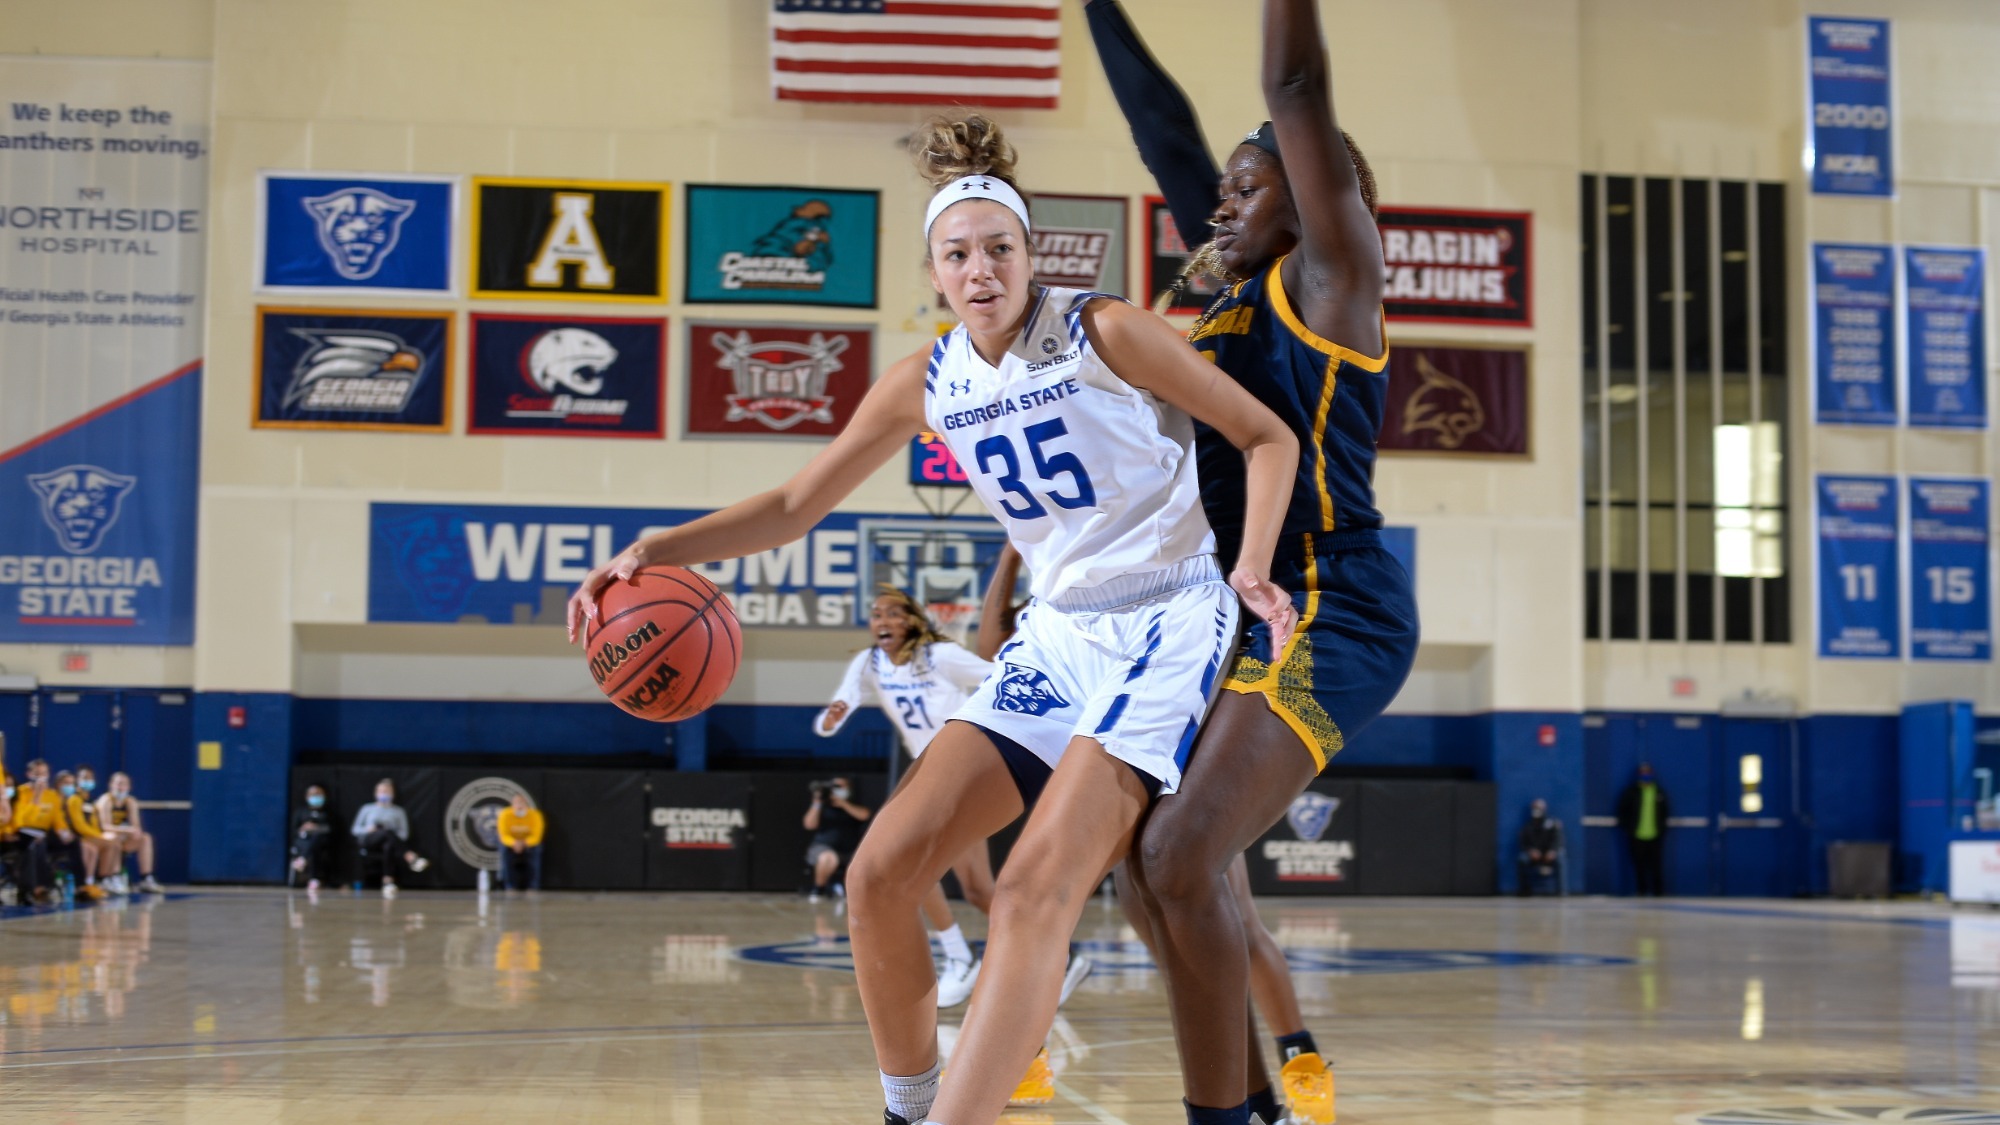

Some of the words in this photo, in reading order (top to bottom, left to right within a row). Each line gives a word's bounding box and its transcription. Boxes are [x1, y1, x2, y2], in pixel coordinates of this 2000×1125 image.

[12, 103, 51, 122] We
[60, 104, 121, 127] keep
[129, 106, 172, 125] the
[1815, 103, 1889, 130] 2000
[0, 132, 94, 151] anthers
[103, 135, 207, 160] moving.
[20, 237, 158, 256] HOSPITAL
[527, 193, 615, 288] A
[39, 290, 88, 303] Health
[94, 291, 128, 304] Care
[132, 292, 196, 305] Provider
[9, 310, 70, 327] Georgia
[75, 311, 114, 325] State
[118, 312, 185, 327] Athletics
[749, 365, 811, 399] TROY
[943, 398, 1019, 430] GEORGIA
[1019, 378, 1080, 411] STATE
[975, 416, 1097, 520] 35
[465, 522, 856, 588] WELME
[875, 530, 975, 590] TO
[0, 556, 162, 587] GEORGIA
[1840, 563, 1877, 602] 11
[1926, 565, 1975, 605] 15
[19, 587, 137, 617] STATE
[590, 620, 663, 685] Wilson
[620, 663, 681, 711] NCAA
[896, 695, 935, 730] 21
[651, 807, 747, 828] GEORGIA
[665, 826, 734, 844] STATE
[1262, 839, 1355, 861] GEORGIA
[1277, 859, 1342, 876] STATE
